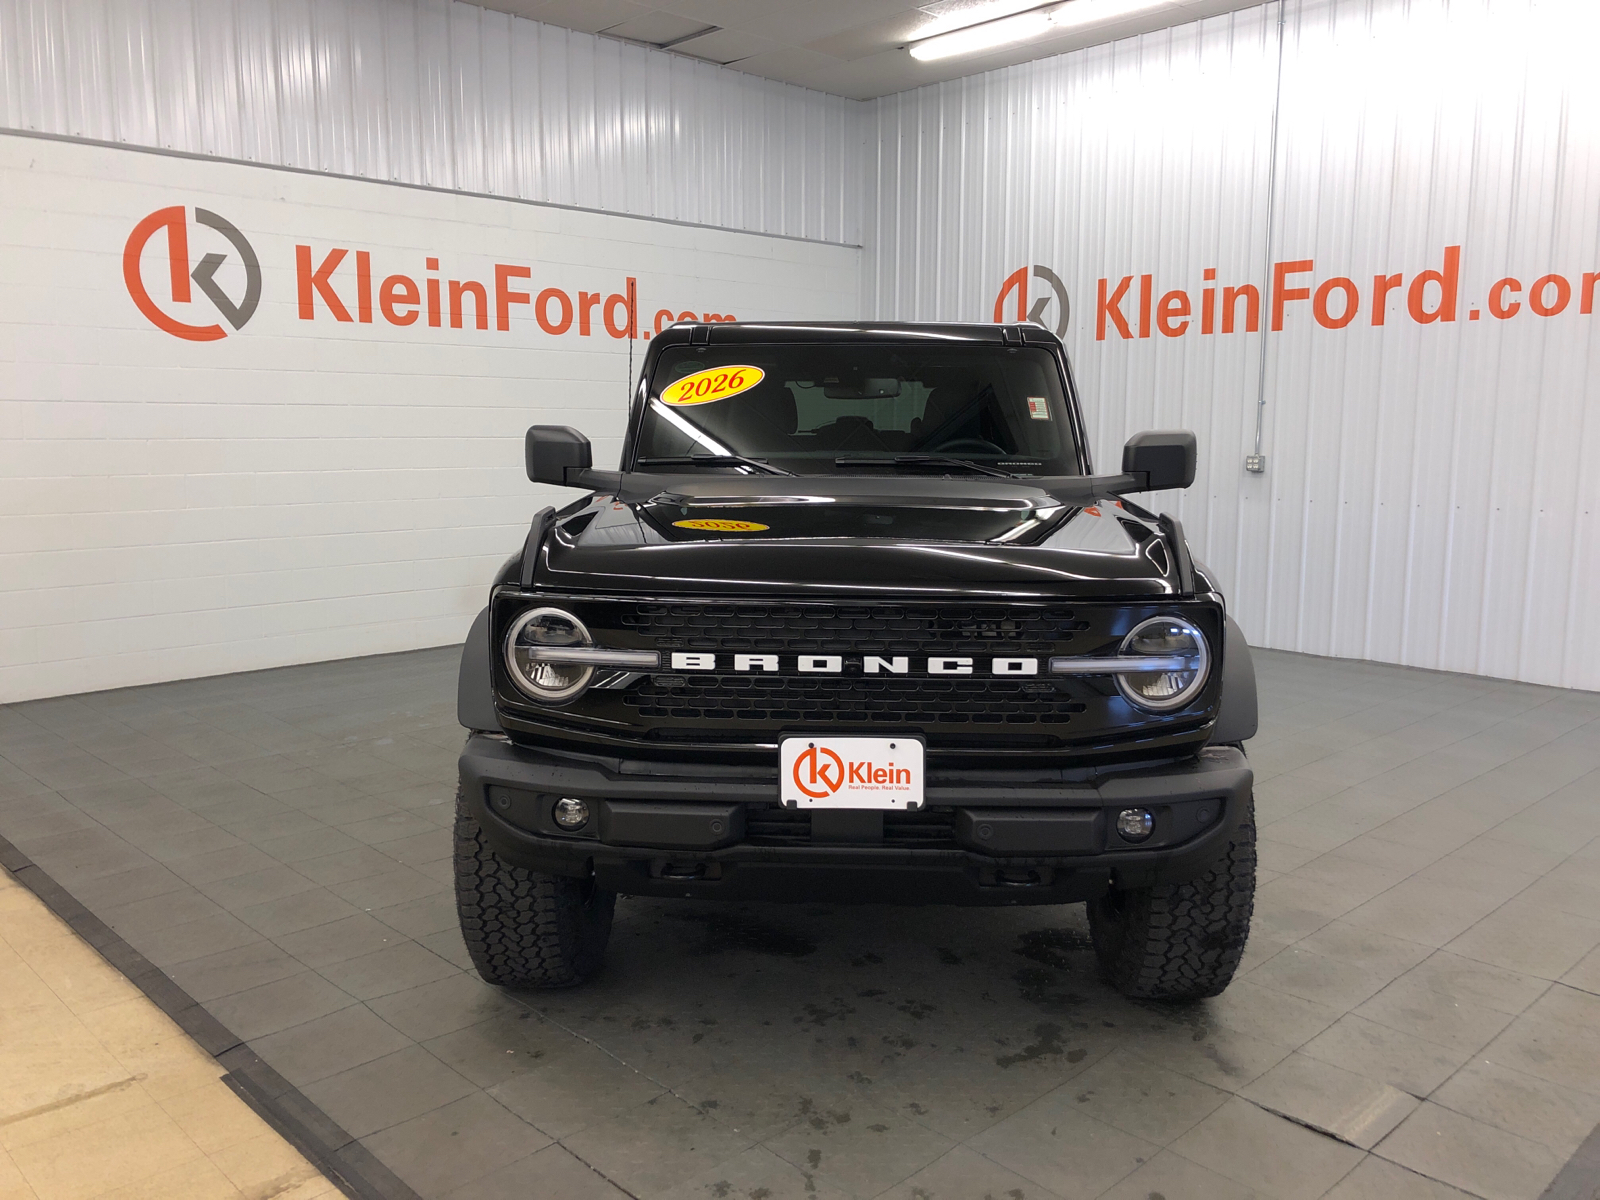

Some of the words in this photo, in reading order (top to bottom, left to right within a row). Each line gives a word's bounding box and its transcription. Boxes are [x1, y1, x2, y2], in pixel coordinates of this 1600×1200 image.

[677, 368, 747, 403] 2026
[671, 652, 1039, 675] BRONCO
[848, 761, 911, 785] Klein
